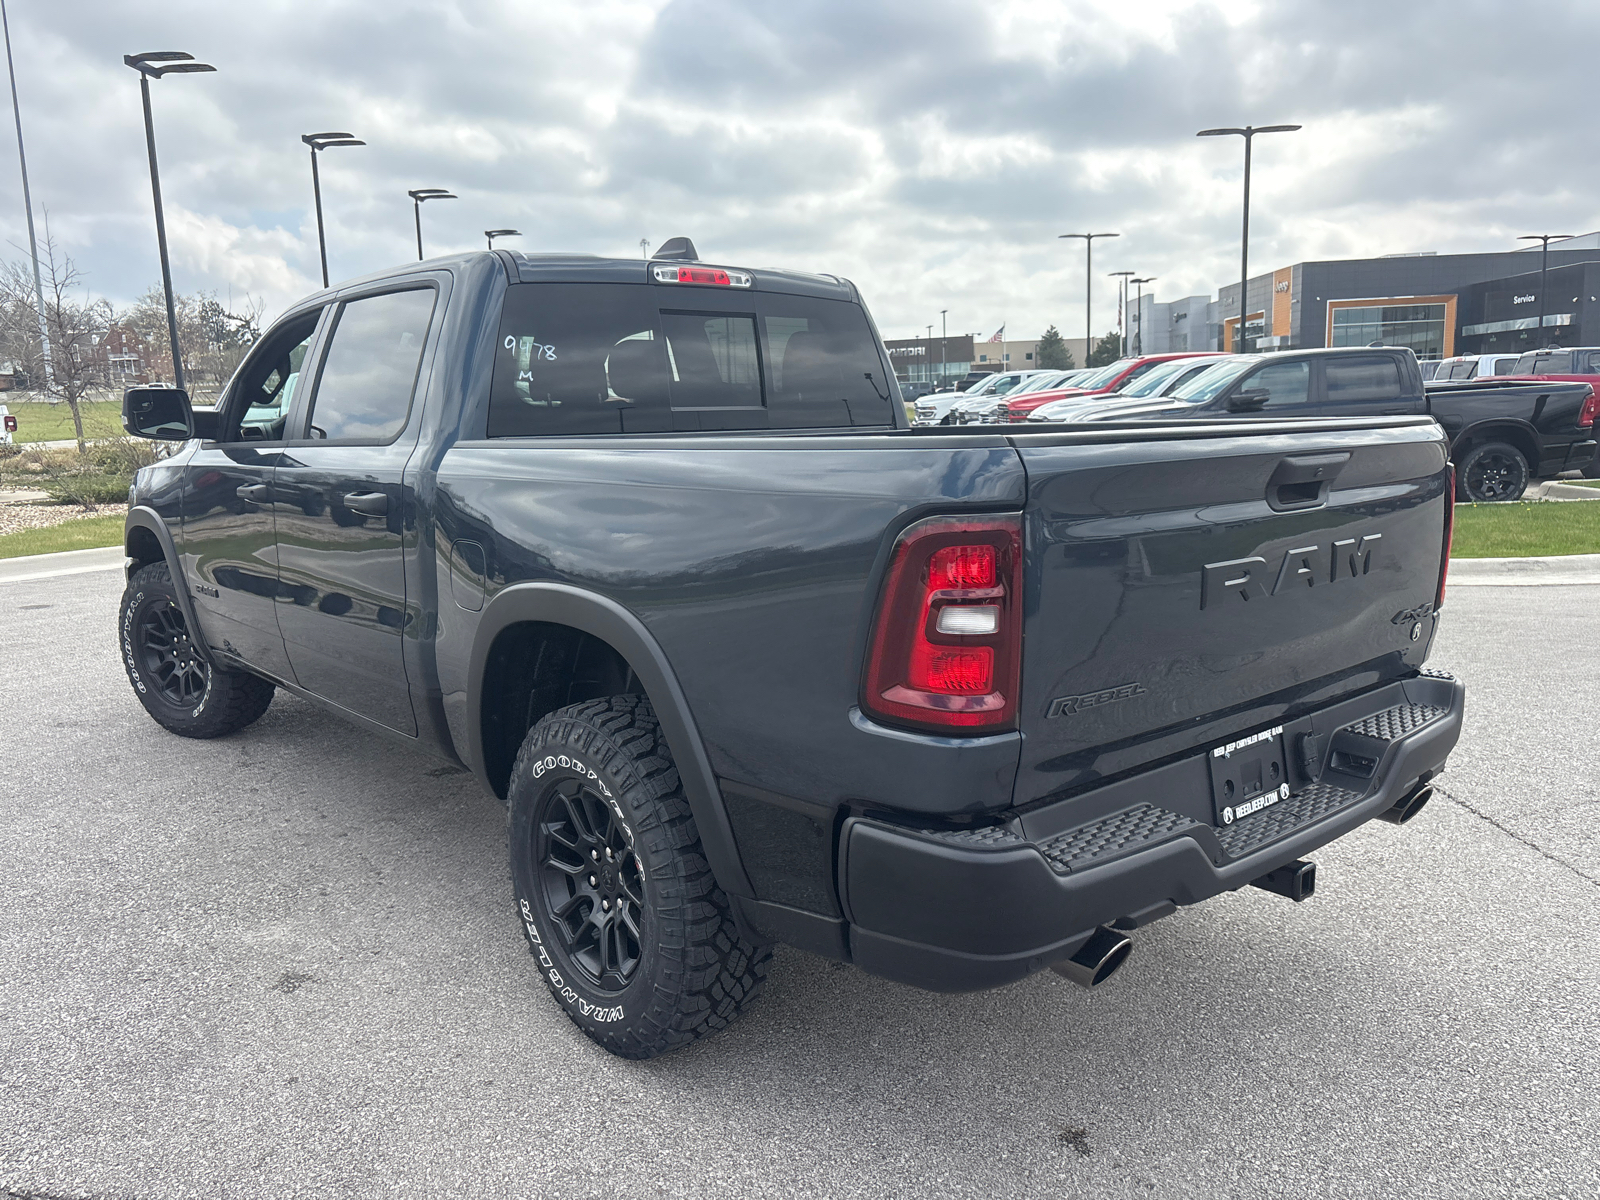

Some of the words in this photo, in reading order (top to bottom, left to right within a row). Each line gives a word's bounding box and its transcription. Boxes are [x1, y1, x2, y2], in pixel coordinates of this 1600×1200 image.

[1513, 294, 1536, 305] Service
[504, 334, 558, 361] 9478
[1199, 533, 1382, 611] RAM
[1044, 681, 1147, 719] REBEL
[1226, 742, 1235, 753] JEEP
[1236, 735, 1257, 749] CHRYSLER
[1258, 729, 1271, 741] DODGE
[1272, 725, 1283, 736] RAM
[1235, 791, 1279, 819] REEDJEEP.COM
[520, 898, 625, 1023] WRANGLER
